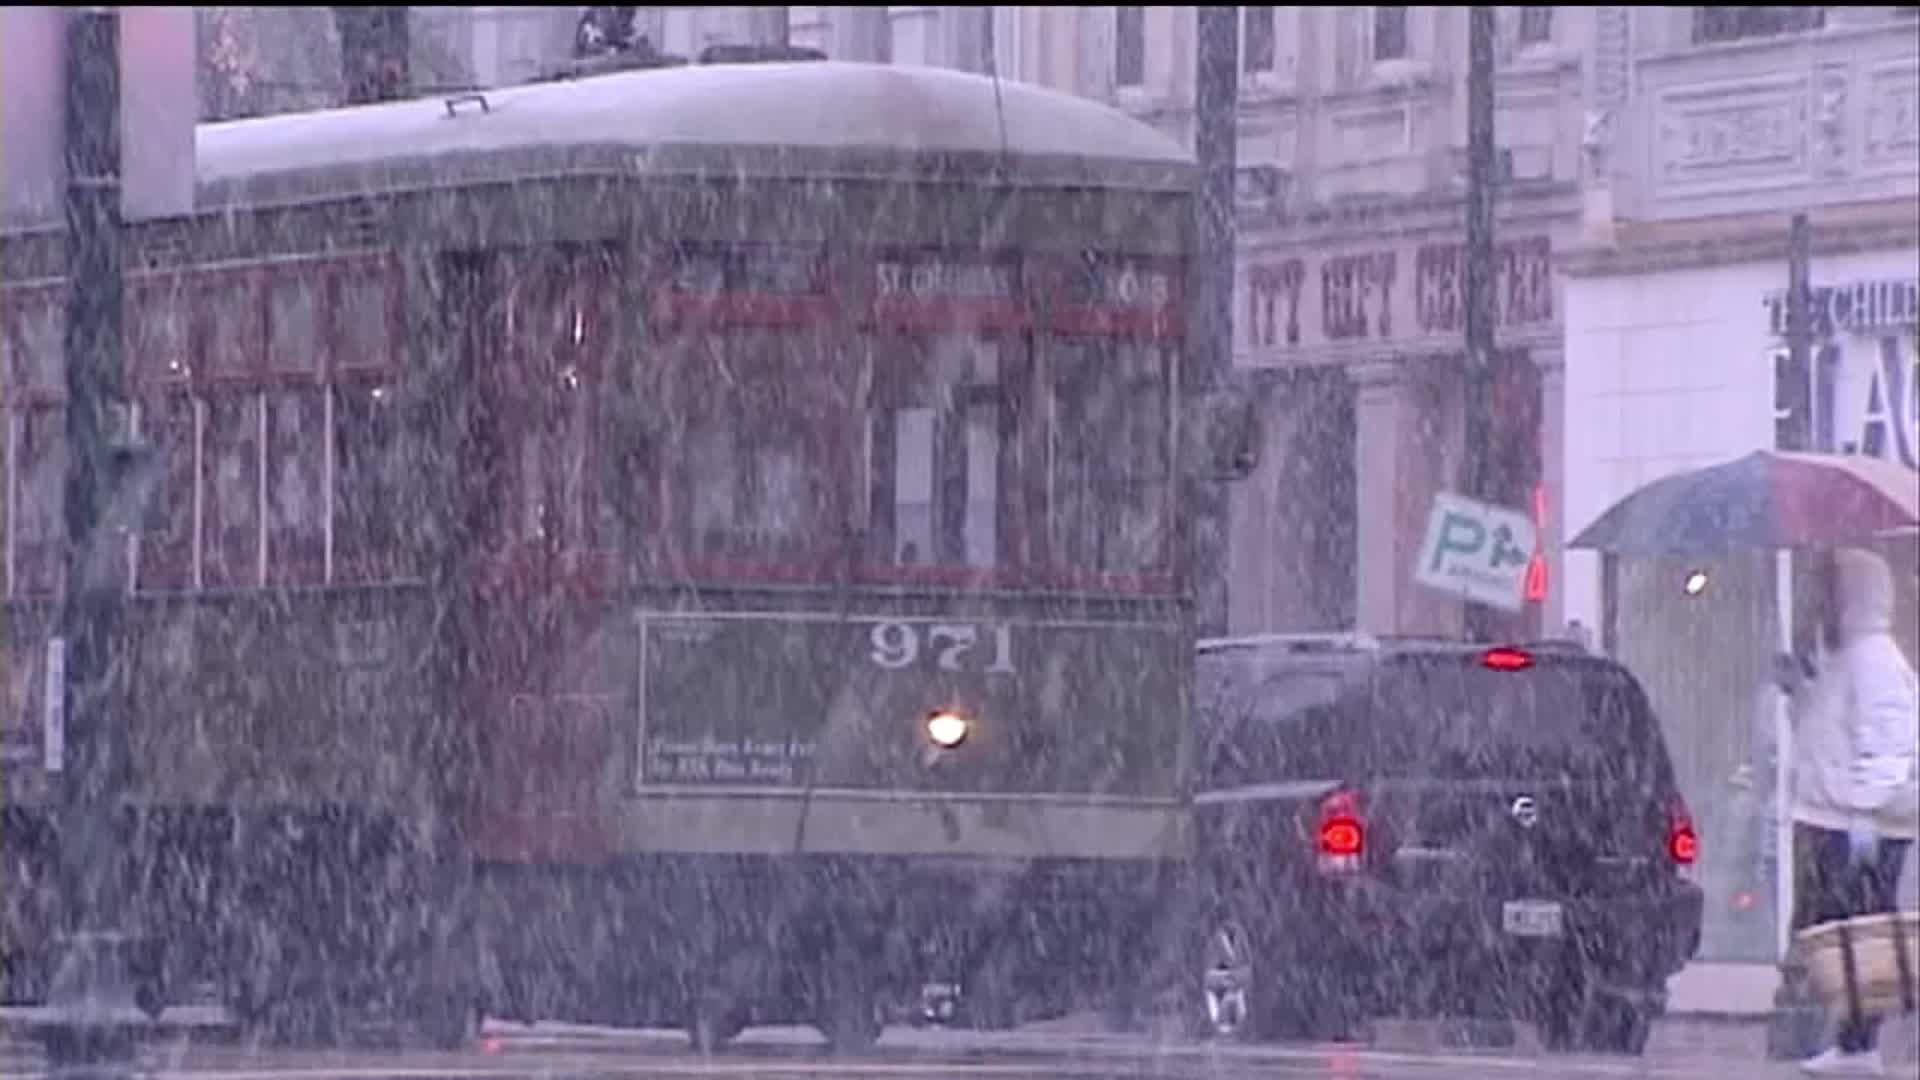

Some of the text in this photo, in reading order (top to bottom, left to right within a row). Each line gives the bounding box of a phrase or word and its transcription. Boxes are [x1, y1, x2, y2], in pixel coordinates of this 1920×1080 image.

[1320, 250, 1397, 340] GIFT
[1414, 236, 1553, 334] CETER
[1431, 511, 1488, 573] P
[871, 622, 1017, 673] 971
